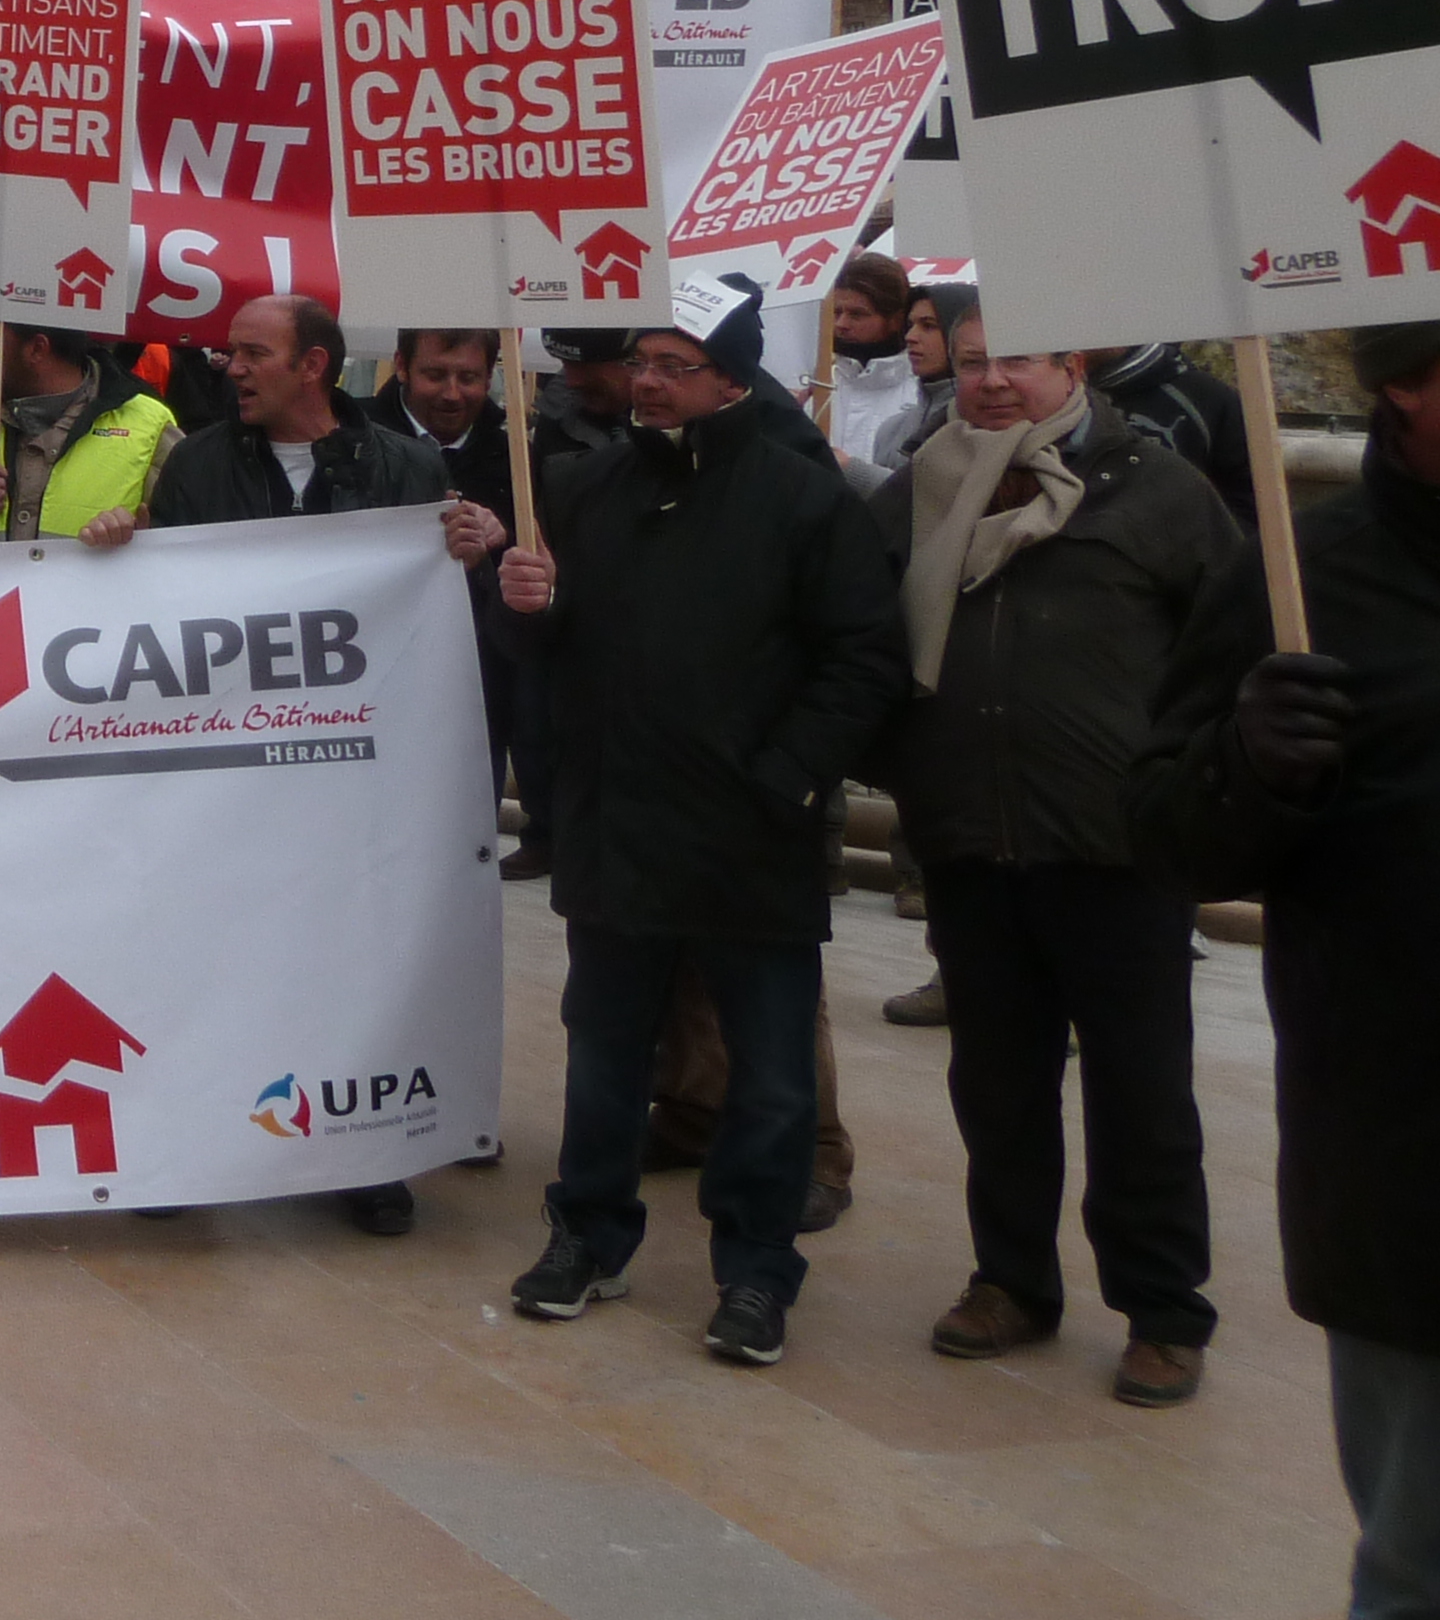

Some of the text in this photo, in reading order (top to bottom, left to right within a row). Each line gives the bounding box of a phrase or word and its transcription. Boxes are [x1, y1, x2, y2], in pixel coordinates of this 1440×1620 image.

[344, 7, 426, 63] ON
[663, 20, 753, 41] Bâtiment
[350, 56, 629, 142] CASSE
[749, 36, 944, 108] ARTISANS
[735, 108, 777, 136] DU
[780, 72, 924, 126] BÂTIMENT,
[353, 138, 634, 185] LES BRIQUES
[718, 129, 782, 169] ON
[783, 100, 910, 156] NOUS
[693, 136, 893, 215] CASSE
[671, 185, 867, 242] LES BRIQUES
[1272, 250, 1340, 272] CAPEB
[42, 609, 367, 705] CAPEB
[201, 709, 236, 733] du
[241, 701, 376, 733] Bâtiment
[264, 741, 367, 763] HÉRAULT
[320, 1066, 438, 1117] UPA
